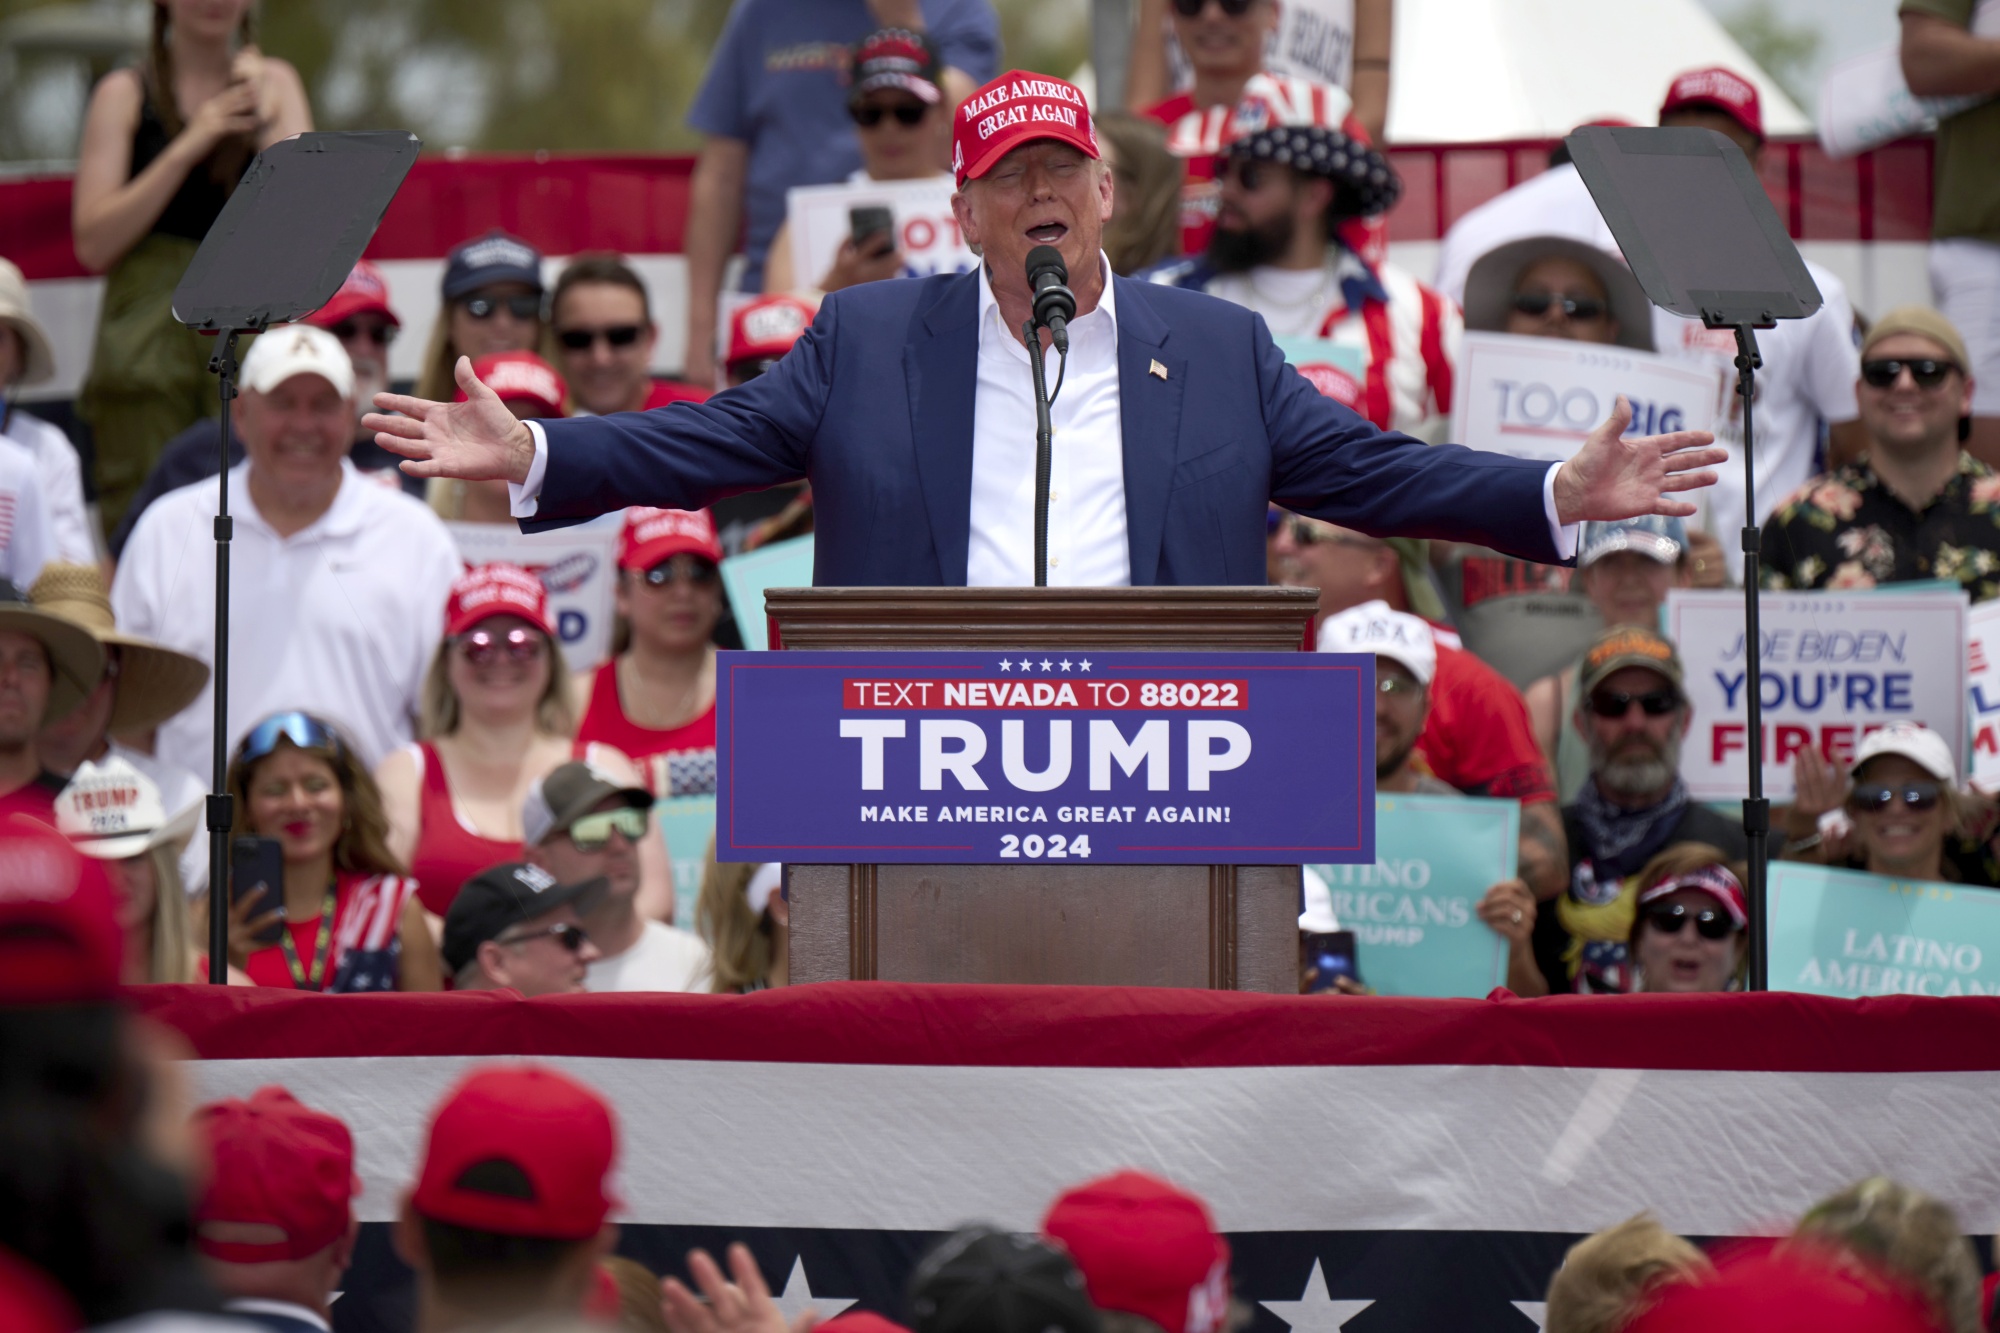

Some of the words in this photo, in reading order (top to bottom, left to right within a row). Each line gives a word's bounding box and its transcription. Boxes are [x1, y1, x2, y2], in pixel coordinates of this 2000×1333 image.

[963, 85, 1010, 122] MAKE
[1010, 80, 1083, 107] AMERICA
[977, 105, 1028, 140] GREAT
[1031, 104, 1077, 130] AGAIN
[1493, 378, 1599, 431] TOO
[853, 683, 933, 706] TEXT
[944, 683, 1078, 706] NEVADA
[1088, 683, 1130, 706] TO
[1140, 683, 1239, 707] 88022
[1714, 671, 1913, 712] YOU'RE
[839, 719, 1252, 792] TRUMP
[72, 787, 138, 813] TRUMP
[860, 806, 928, 822] MAKE
[938, 806, 1048, 822] AMERICA
[1057, 806, 1136, 823] GREAT
[1145, 806, 1231, 823] AGAIN!
[1000, 834, 1091, 858] 2024
[1313, 857, 1431, 890] ATINO
[1332, 889, 1470, 928] RICANS
[1342, 923, 1424, 947] RUMP
[1843, 928, 1982, 975] LATINO
[1797, 957, 2000, 997] AMERICAN
